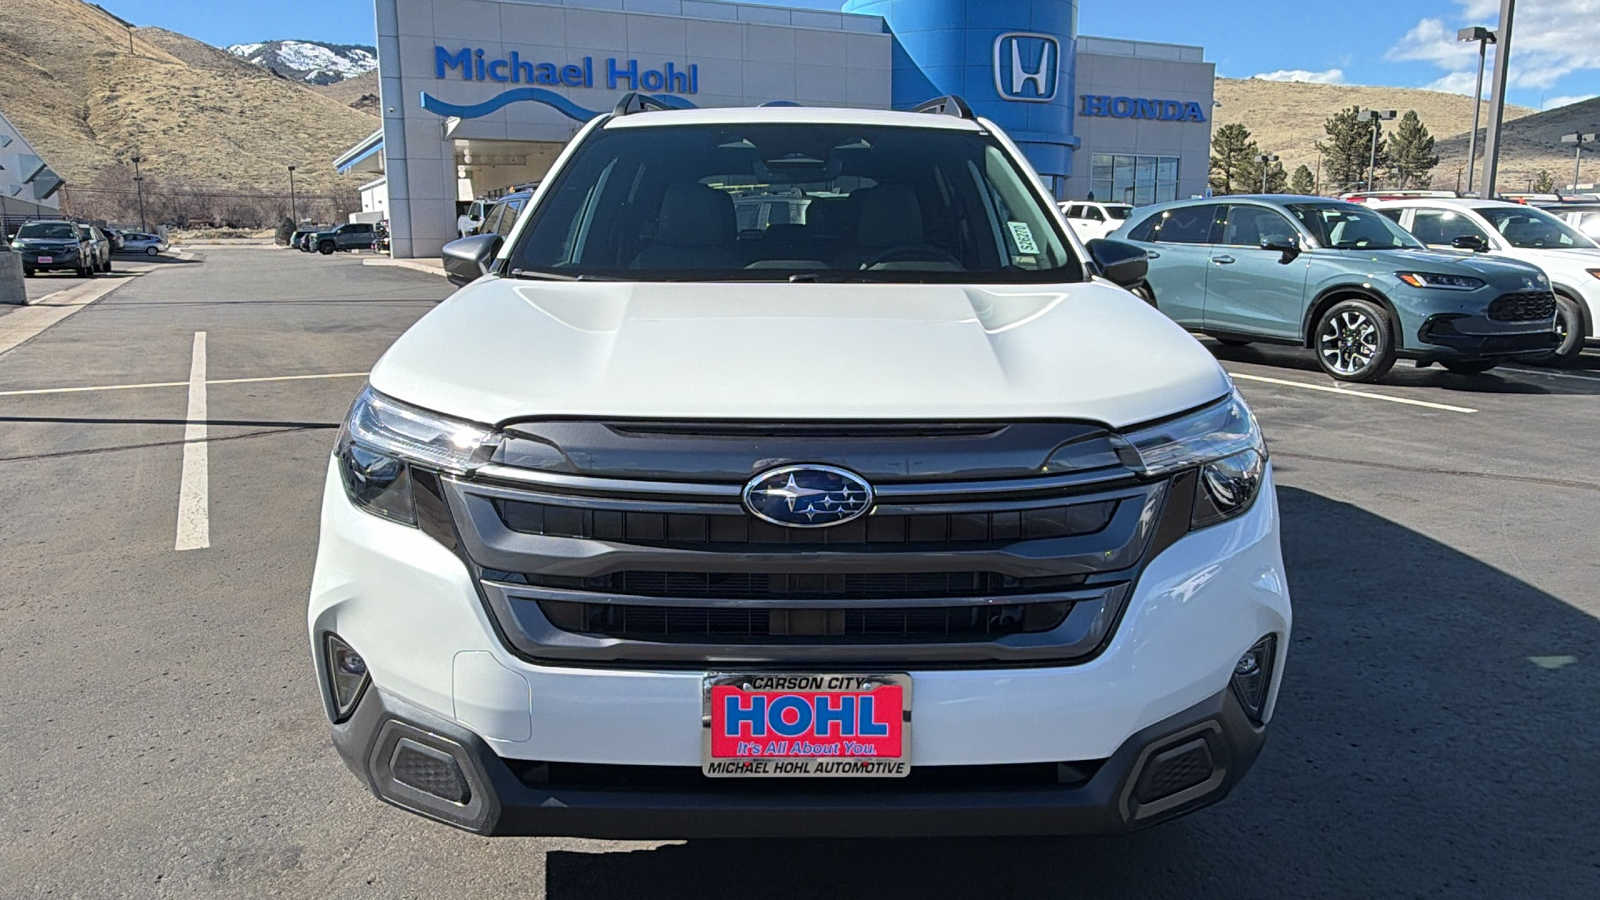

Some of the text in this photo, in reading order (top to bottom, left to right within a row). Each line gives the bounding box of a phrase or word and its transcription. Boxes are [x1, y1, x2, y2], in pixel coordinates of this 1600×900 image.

[434, 45, 698, 94] Michael Hohl
[1079, 94, 1207, 123] HONDA
[752, 677, 866, 690] CARSON CITY
[725, 695, 888, 737] HOHL
[737, 741, 876, 755] It's All About You.
[708, 761, 905, 774] MICHAEL HOHL AUTOMOTIVE
